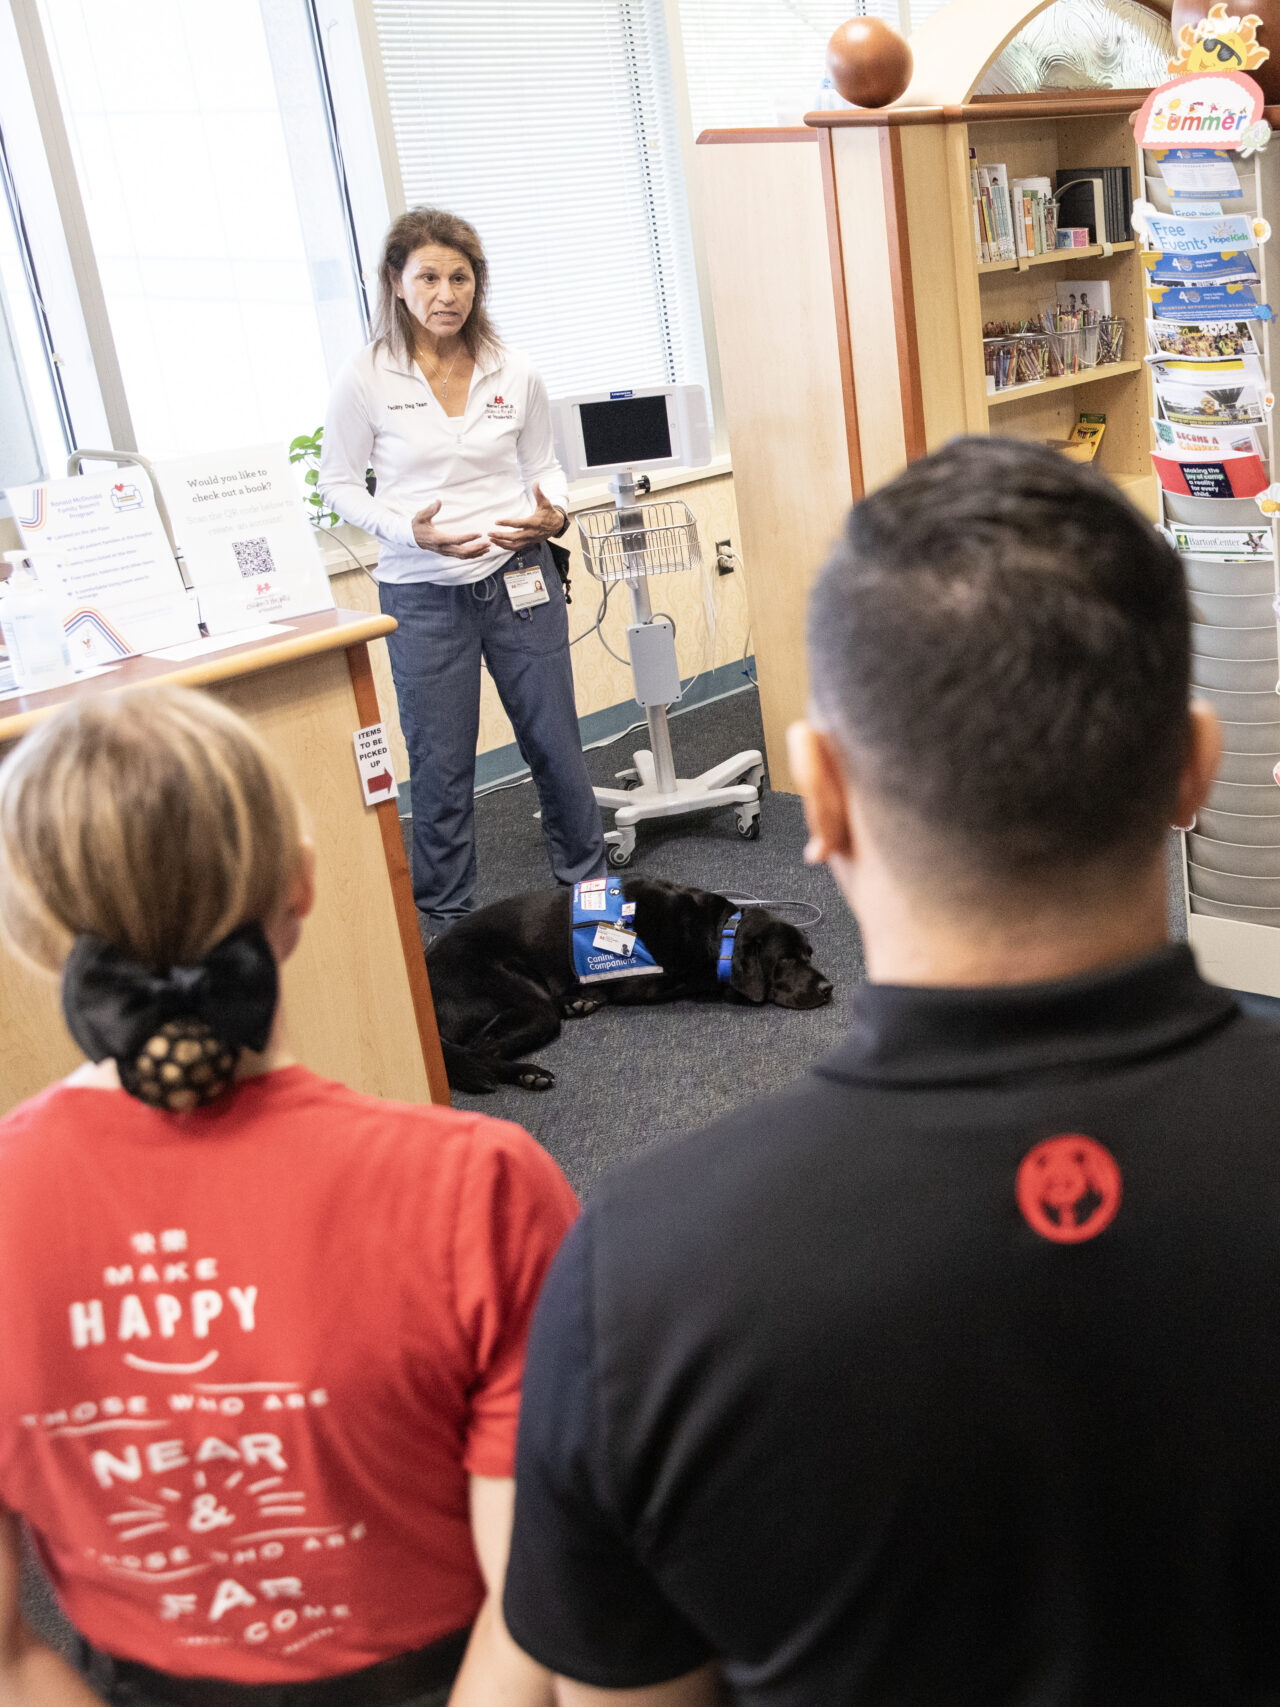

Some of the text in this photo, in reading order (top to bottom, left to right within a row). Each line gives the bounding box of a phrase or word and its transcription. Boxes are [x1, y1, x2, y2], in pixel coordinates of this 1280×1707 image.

[1151, 221, 1186, 237] Free
[1158, 237, 1208, 251] Events
[1208, 232, 1249, 244] HopeKids
[1199, 322, 1238, 336] 2024
[404, 402, 415, 410] Dog
[1212, 436, 1220, 444] A
[187, 468, 268, 488] Would you like to
[1183, 467, 1208, 475] Making
[192, 481, 272, 504] check out a book?
[358, 727, 382, 740] ITEMS
[359, 738, 383, 750] TO BE
[359, 747, 388, 761] PICKED
[370, 760, 381, 768] UP
[587, 953, 615, 963] Canine
[589, 957, 637, 971] Companions
[102, 1257, 219, 1287] MAKE
[69, 1284, 259, 1350] HAPPY
[168, 1392, 245, 1417] WHO
[263, 1387, 329, 1412] ARE
[89, 1432, 289, 1491] NEAR
[187, 1492, 236, 1534] &
[158, 1575, 305, 1623] FAR
[243, 1602, 353, 1645] COME
